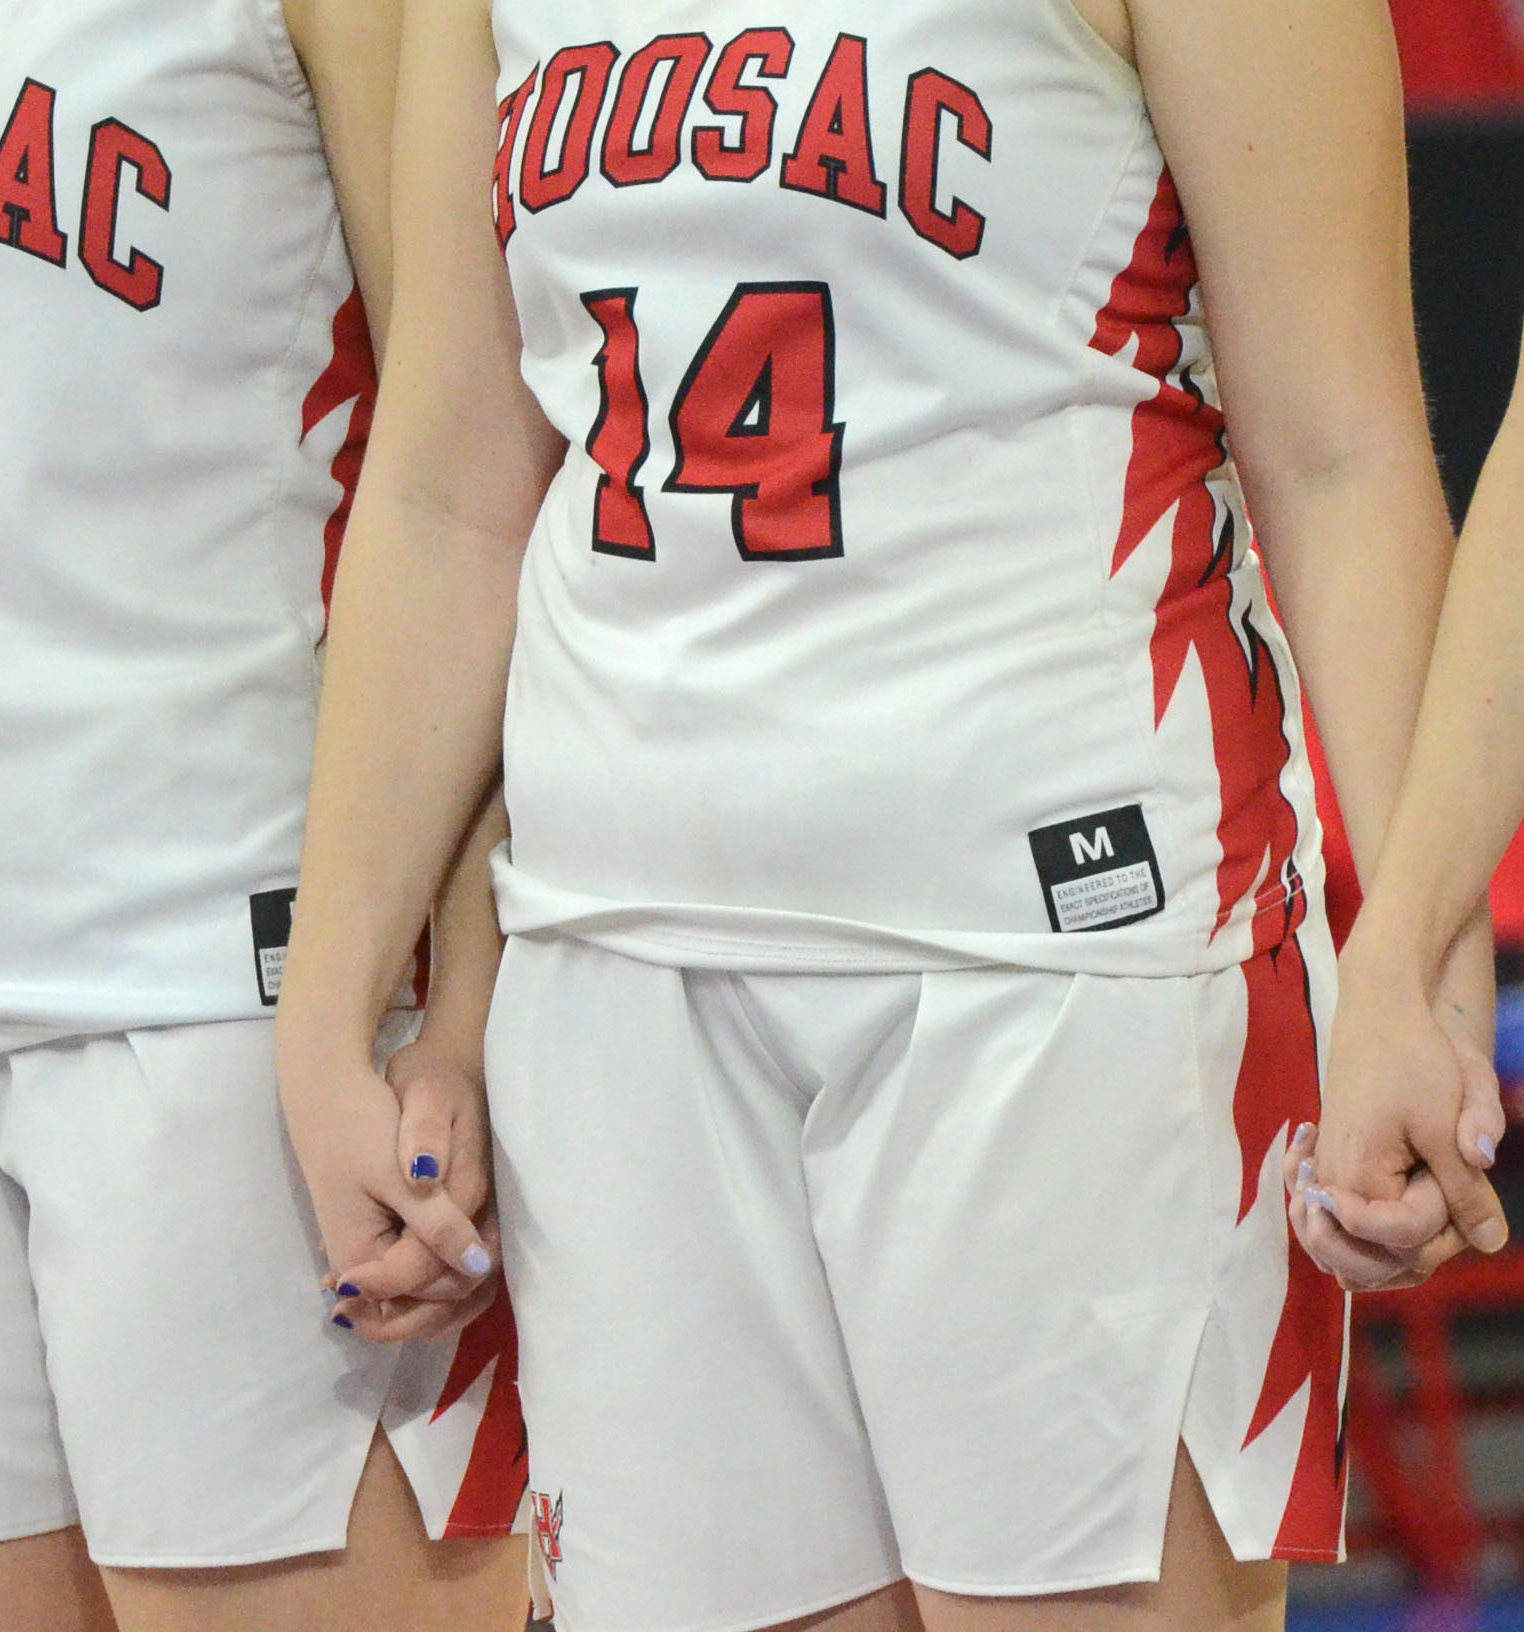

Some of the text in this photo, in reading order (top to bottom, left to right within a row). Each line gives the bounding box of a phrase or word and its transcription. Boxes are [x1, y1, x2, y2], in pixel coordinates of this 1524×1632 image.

[579, 280, 846, 562] 14
[1069, 826, 1114, 865] M
[1057, 868, 1147, 899] ENGINEERED TO THE
[1060, 899, 1083, 912] EXACT
